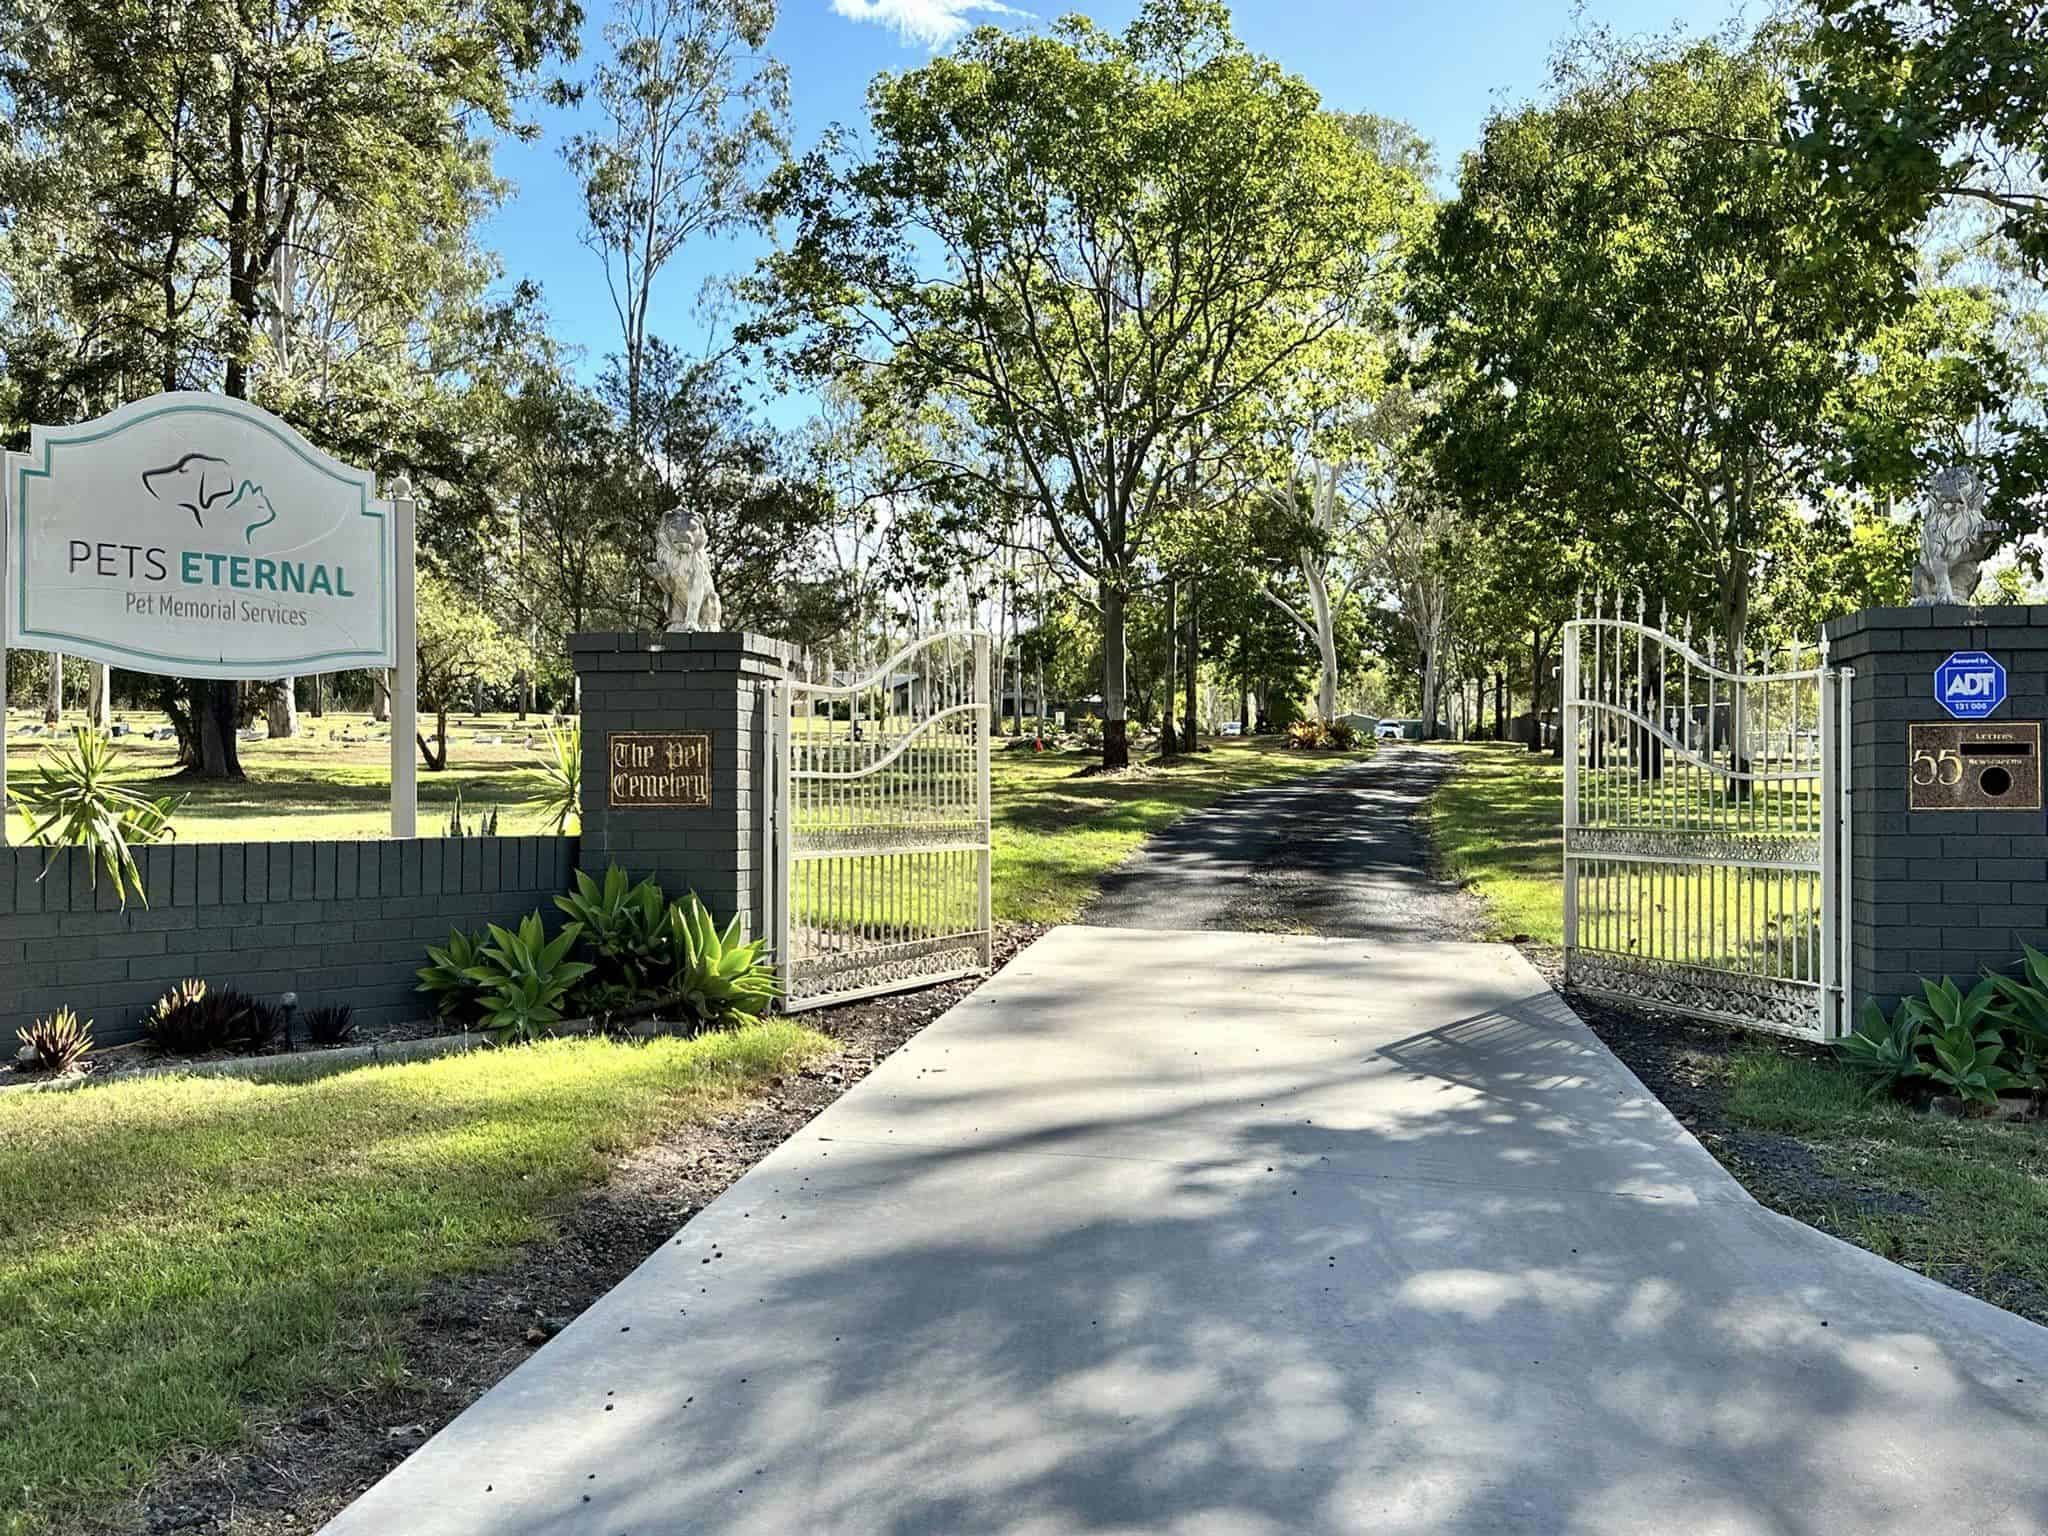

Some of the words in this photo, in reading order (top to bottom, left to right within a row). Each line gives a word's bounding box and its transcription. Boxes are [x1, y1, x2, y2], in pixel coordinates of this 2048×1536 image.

[69, 540, 167, 580] PETS
[181, 551, 354, 597] ETERNAL
[126, 592, 154, 615] Pet
[160, 597, 236, 621] Memorial
[241, 602, 307, 626] Services
[1947, 673, 1993, 696] ADT
[614, 742, 654, 768] The
[666, 742, 702, 769] Pet
[1913, 749, 1963, 785] 55
[614, 773, 707, 802] Cemetery
